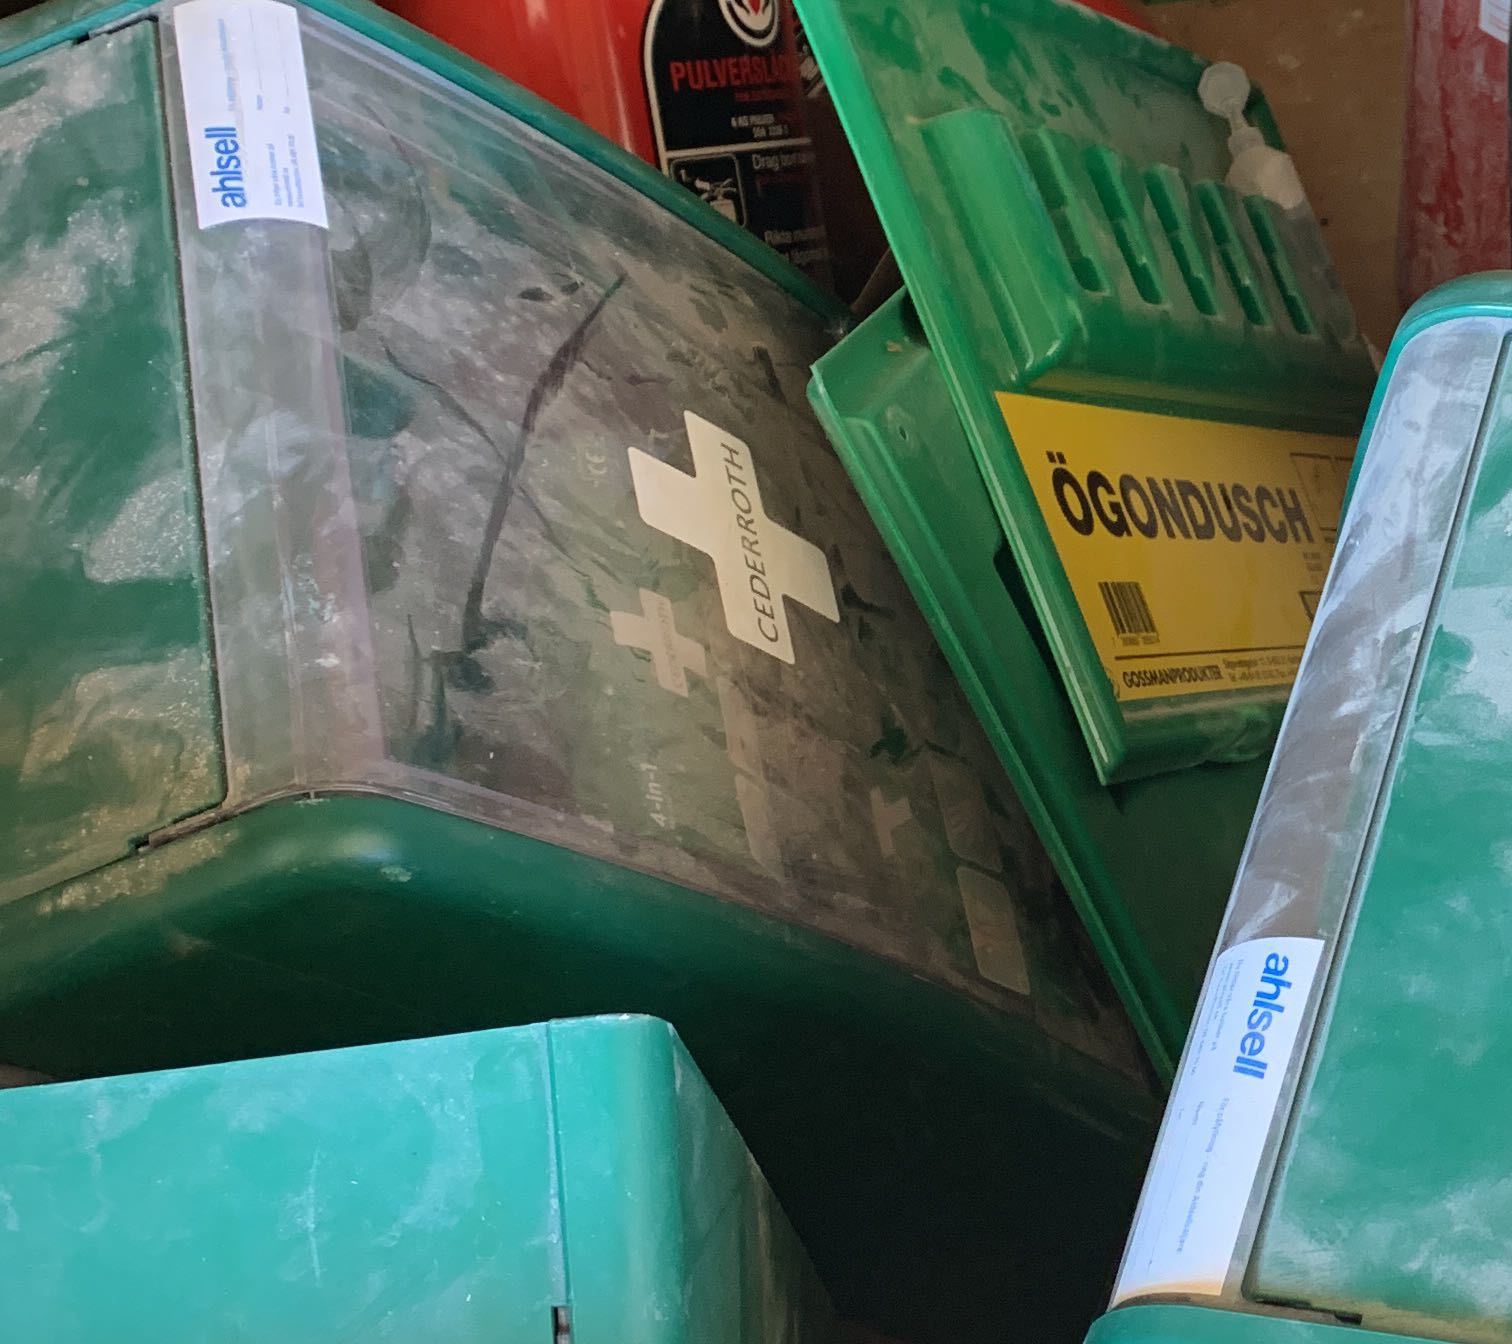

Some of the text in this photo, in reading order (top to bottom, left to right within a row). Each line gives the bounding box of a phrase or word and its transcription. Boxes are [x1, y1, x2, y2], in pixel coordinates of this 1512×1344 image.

[204, 126, 248, 209] ahlsell
[720, 441, 779, 644] CEDERROTH
[1045, 449, 1316, 545] ÖGONDUSCH
[1232, 951, 1293, 1080] ahlsell
